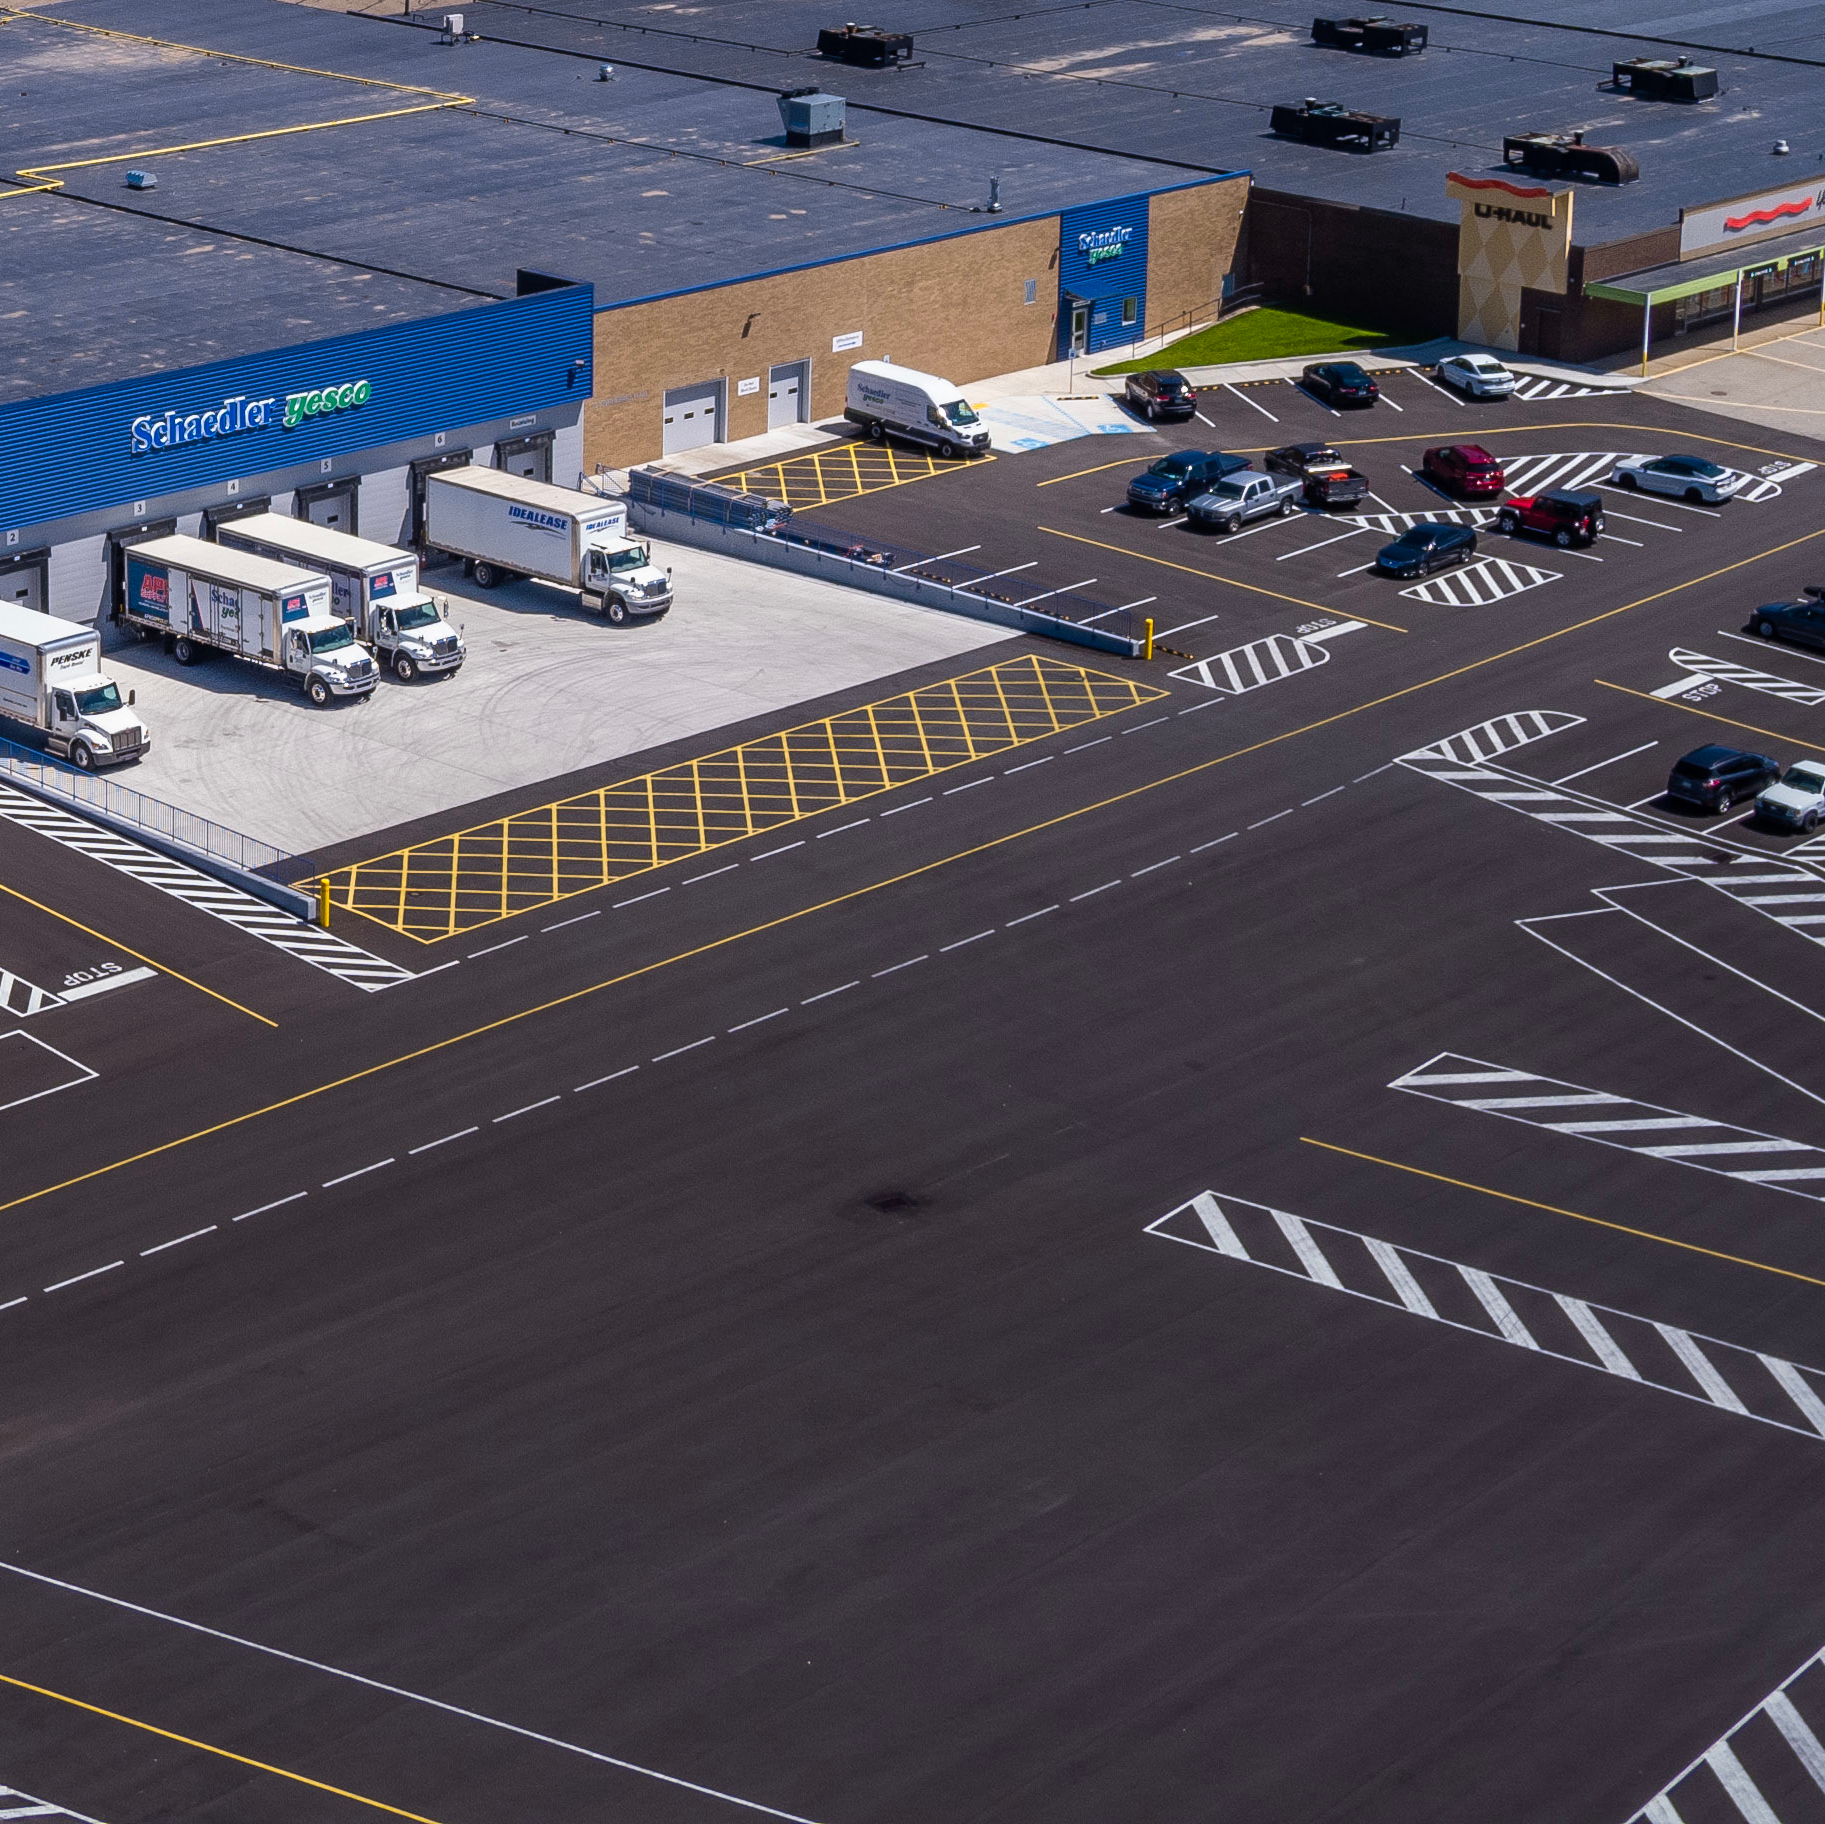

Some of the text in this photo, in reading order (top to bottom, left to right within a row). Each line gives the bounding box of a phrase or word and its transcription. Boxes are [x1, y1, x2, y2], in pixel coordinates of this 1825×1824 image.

[1475, 202, 1553, 230] U-HAUL
[131, 380, 371, 454] Schaedler yesco
[437, 434, 443, 445] 6
[324, 460, 329, 471] 5
[230, 482, 236, 492] 4
[136, 503, 143, 513] 3
[508, 506, 568, 530] IDEALEASE
[585, 517, 620, 531] IDEALEASE
[10, 532, 17, 543] 2
[211, 589, 240, 609] Scha
[1295, 618, 1337, 634] STOP
[51, 648, 93, 667] PENSKE
[1682, 683, 1723, 702] STOP
[64, 962, 123, 987] STOP
